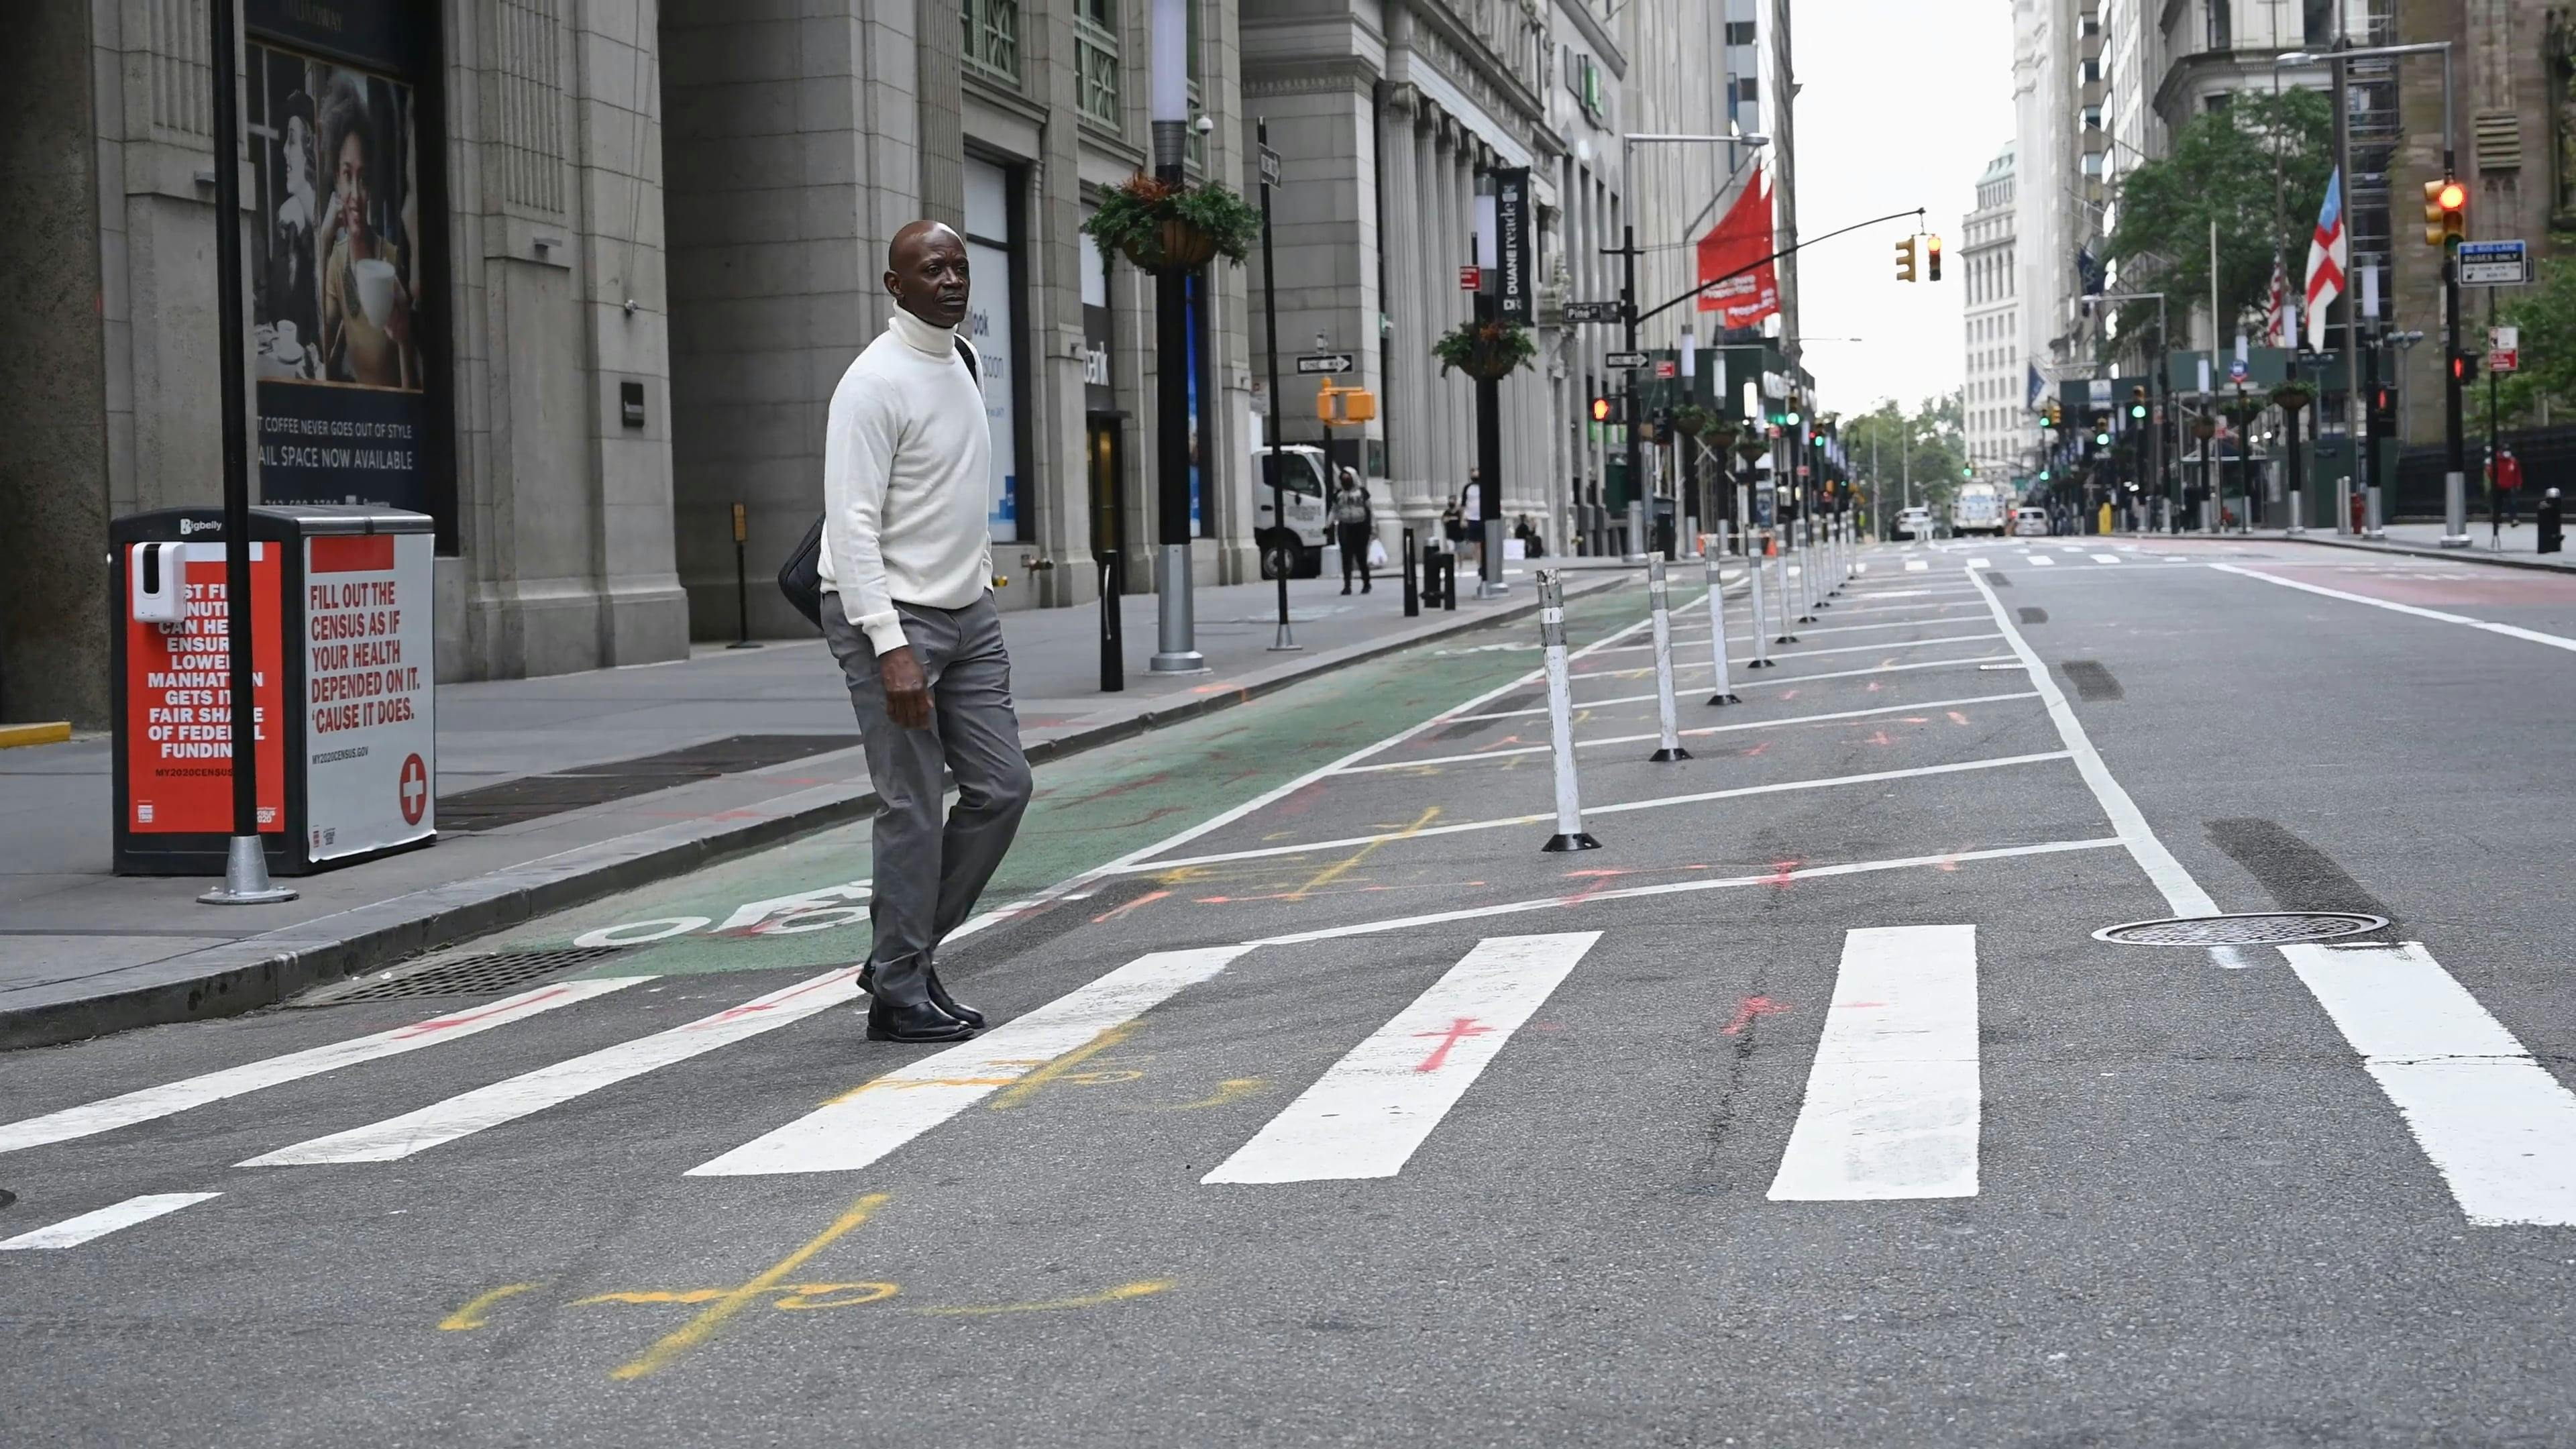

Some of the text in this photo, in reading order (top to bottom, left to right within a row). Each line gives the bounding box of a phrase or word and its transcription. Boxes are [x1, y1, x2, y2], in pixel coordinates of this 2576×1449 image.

[1303, 360, 1344, 370] ONE WAY
[265, 417, 299, 433] COFFEE
[301, 419, 328, 435] NEVER
[331, 421, 354, 437] GOES
[355, 423, 372, 437] OUT
[374, 423, 386, 437] OF
[388, 424, 413, 439] STYLE
[258, 445, 413, 470] AIL SPACE NOW AVAILABLE
[180, 519, 222, 535] Bigbelly
[310, 581, 395, 610] FILL OUT THE
[158, 619, 229, 634] CAN HE
[311, 610, 400, 641] CENSUS AS IF
[167, 637, 229, 652] ENSUR
[312, 639, 400, 672] YOUR HEALTH
[148, 672, 263, 688] MANHATN
[311, 667, 421, 703] DEPENDED ON IT.
[165, 690, 231, 705] GETS IT
[150, 707, 264, 723] FAIR SHE
[363, 702, 374, 727] IT
[378, 697, 415, 724] DOES.
[148, 724, 266, 741] OF FEDEL
[161, 743, 233, 759] FUNDIN
[312, 746, 369, 765] MY2020CENSUS.GOV
